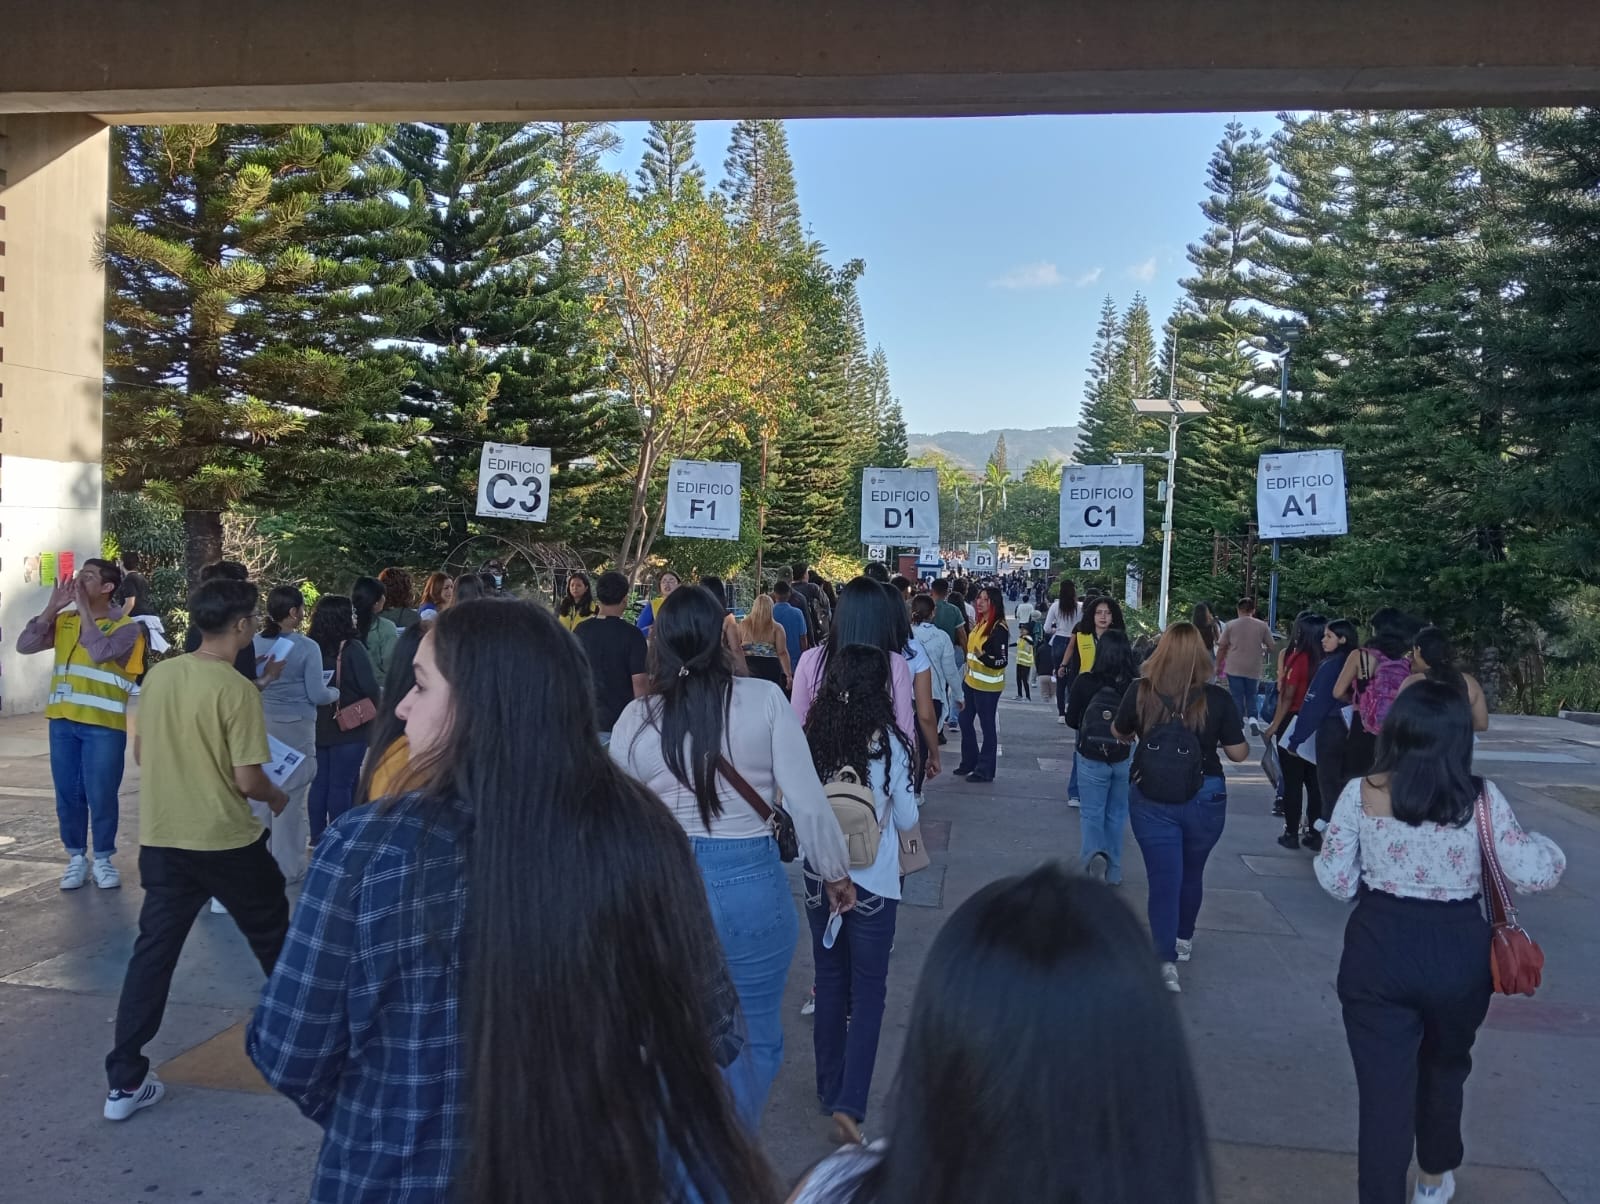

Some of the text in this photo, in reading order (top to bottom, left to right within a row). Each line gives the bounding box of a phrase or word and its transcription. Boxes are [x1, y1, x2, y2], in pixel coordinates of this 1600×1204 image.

[488, 458, 545, 474] EDIFICIO
[677, 482, 734, 495] EDIFICIO
[1266, 474, 1334, 489] EDIFICIO
[486, 473, 542, 512] C3
[871, 490, 930, 502] EDIFICIO
[1070, 487, 1134, 500] EDIFICIO
[690, 499, 716, 520] F1
[1282, 493, 1317, 517] A1
[884, 508, 914, 528] D1
[1084, 505, 1116, 527] C1
[869, 548, 885, 559] C3
[976, 556, 992, 566] D1
[1033, 557, 1048, 568] C1
[1083, 557, 1098, 567] A1
